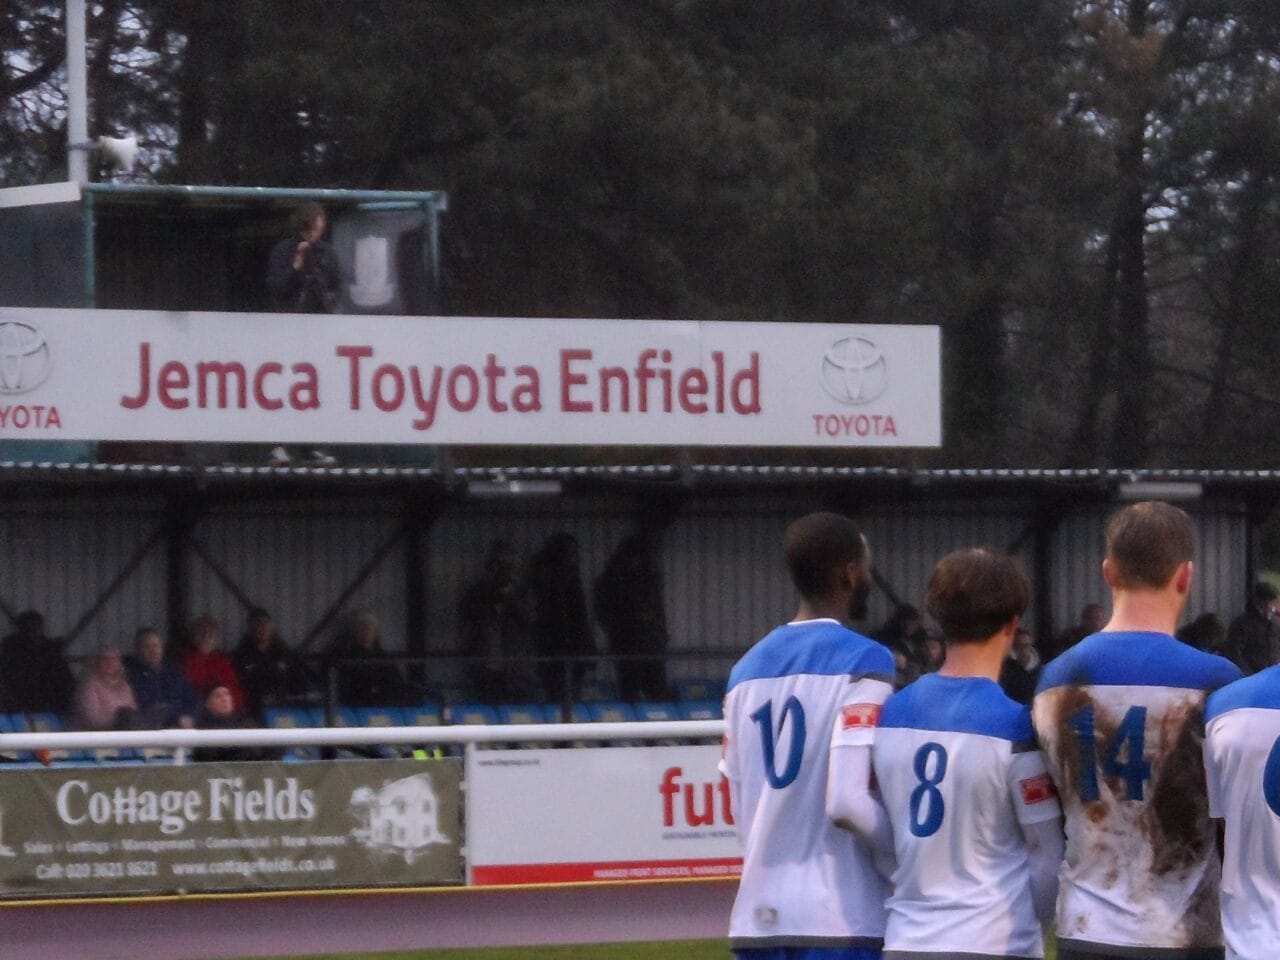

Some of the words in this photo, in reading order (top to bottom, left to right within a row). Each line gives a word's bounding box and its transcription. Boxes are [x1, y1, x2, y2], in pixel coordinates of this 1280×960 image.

[120, 342, 321, 411] Jemca
[336, 345, 542, 430] Toyota
[559, 348, 762, 415] Enfield
[812, 414, 898, 437] TOYOTA
[909, 741, 948, 838] 8
[1070, 704, 1152, 801] 14
[56, 779, 200, 834] Cottage
[206, 777, 316, 822] Fields
